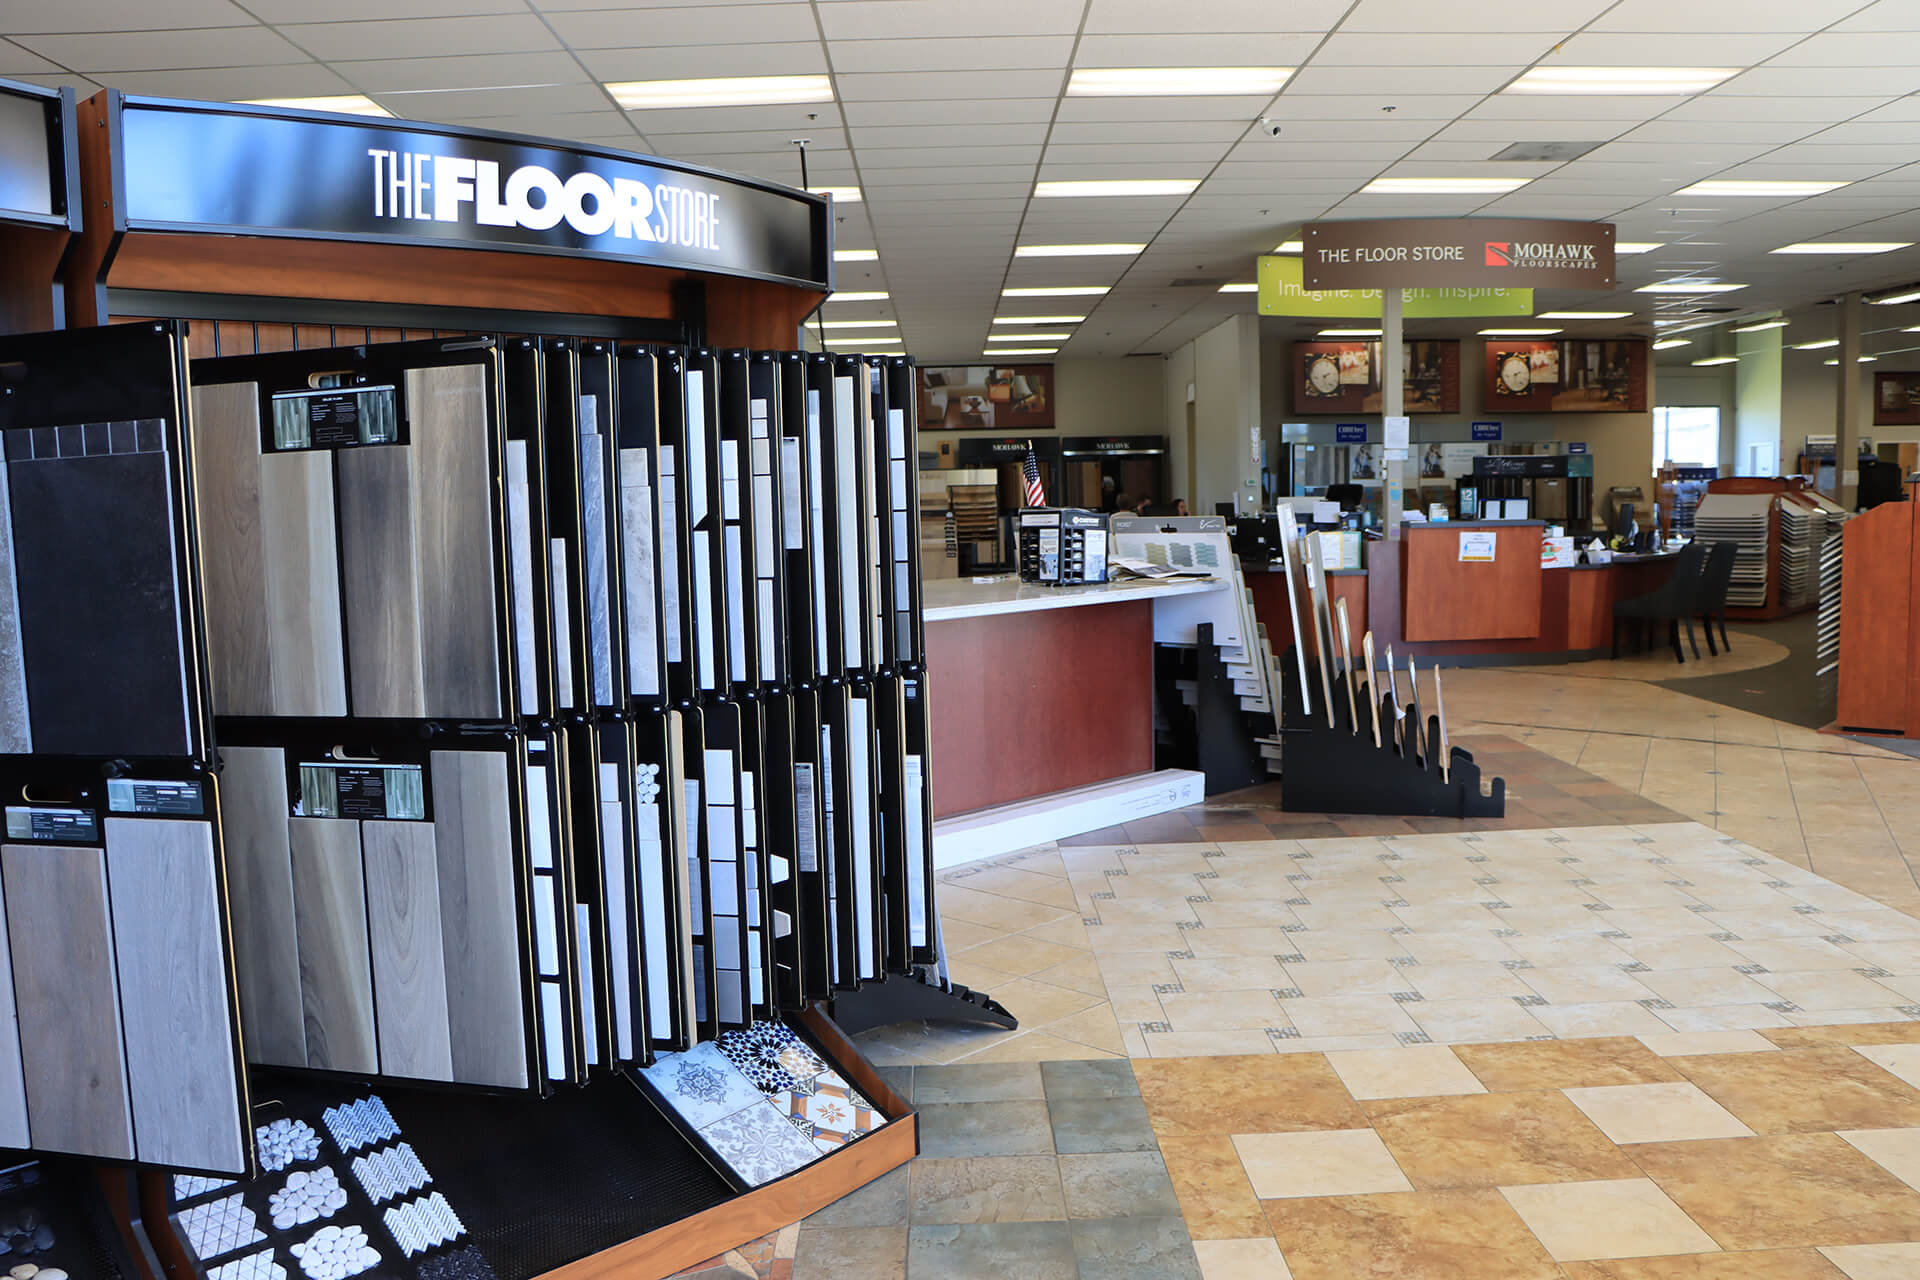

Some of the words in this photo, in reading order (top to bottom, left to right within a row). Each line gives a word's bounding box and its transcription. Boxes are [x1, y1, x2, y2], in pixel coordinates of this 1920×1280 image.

[368, 149, 431, 220] THE
[433, 156, 657, 242] FLOOR
[655, 183, 720, 251] STORE
[1318, 248, 1350, 263] THE
[1355, 247, 1407, 262] FLOOR
[1413, 246, 1464, 261] STORE
[1514, 243, 1595, 260] MOHAWK
[1514, 260, 1597, 269] FLOORSCAPES
